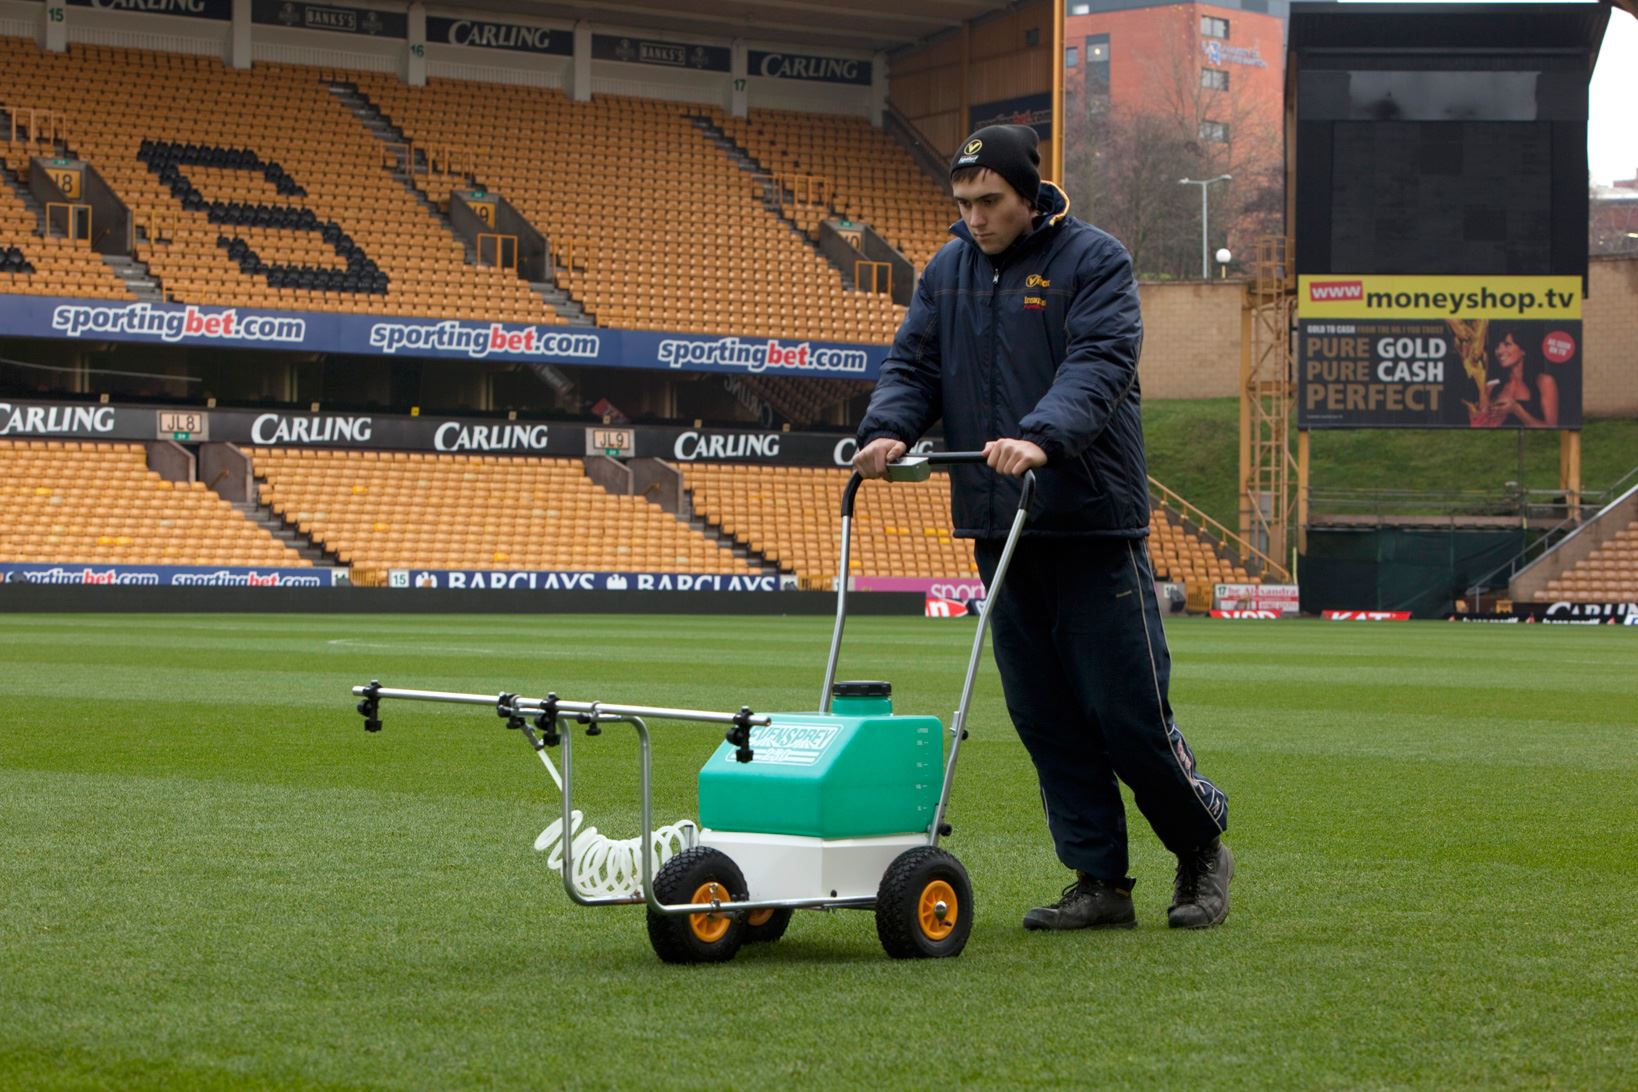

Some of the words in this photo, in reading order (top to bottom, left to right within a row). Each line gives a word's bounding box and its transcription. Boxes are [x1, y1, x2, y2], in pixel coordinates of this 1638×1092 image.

[48, 8, 64, 22] 15
[307, 10, 354, 28] BANKS'S
[449, 20, 550, 48] CARLING
[410, 44, 424, 57] 16
[760, 54, 858, 79] CARLING
[734, 79, 746, 91] 17
[1311, 285, 1361, 299] www
[1366, 287, 1575, 314] moneyshop.tv
[52, 303, 306, 342] sportingbet.com
[369, 320, 599, 359] sportingbet.com
[1307, 337, 1370, 358] PURE
[1376, 337, 1447, 358] GOLD
[657, 337, 867, 373] sportingbet.com
[1307, 361, 1370, 382] PURE
[1376, 361, 1444, 382] CASH
[1306, 384, 1444, 411] PERFECT
[167, 415, 196, 432] JL8
[251, 413, 372, 445] CARLING
[434, 421, 548, 451] CARLING
[600, 431, 624, 448] JL9
[673, 431, 780, 460] CARLING
[5, 567, 159, 585] sortingbet.com
[392, 574, 406, 585] 15
